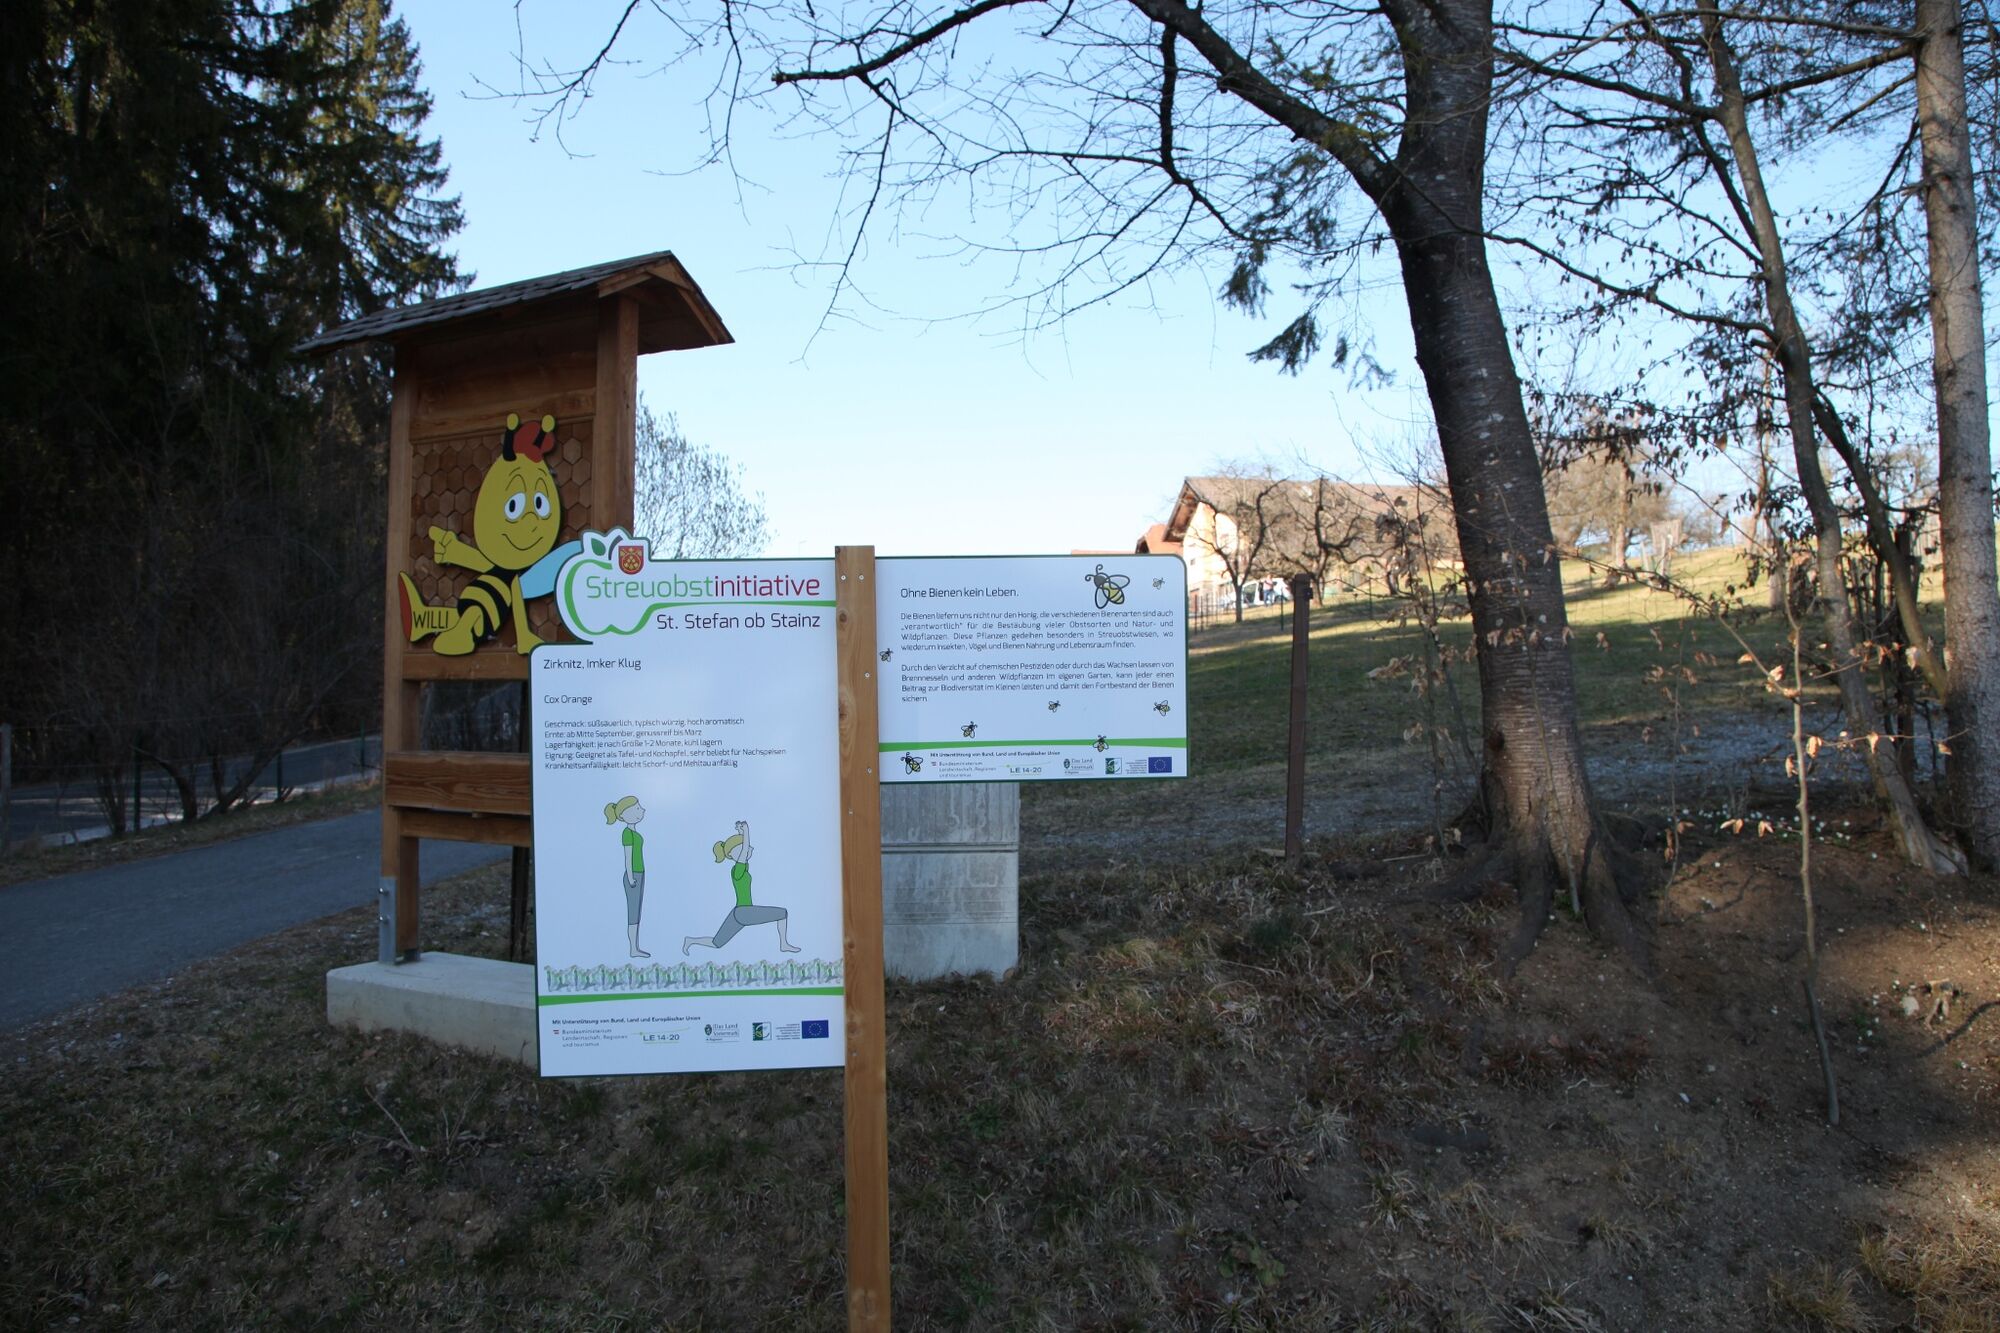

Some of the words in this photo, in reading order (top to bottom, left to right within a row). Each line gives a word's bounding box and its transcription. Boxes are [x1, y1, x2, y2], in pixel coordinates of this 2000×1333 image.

[586, 574, 820, 600] Streuobstinitiative
[900, 587, 927, 598] Ohne
[929, 587, 962, 598] Bienen
[963, 587, 984, 597] kein
[985, 586, 1019, 597] Leben.
[413, 608, 449, 629] WILLI
[900, 612, 912, 620] Die
[912, 612, 935, 620] Bienen
[1004, 611, 1017, 619] den
[1018, 611, 1039, 620] Honig,
[1101, 610, 1142, 618] Bienenarten
[656, 614, 679, 631] St.
[684, 613, 739, 630] Stefan
[744, 613, 766, 629] ob
[770, 612, 820, 629] Stainz
[1132, 620, 1156, 628] Natur-
[953, 632, 973, 640] Diese
[976, 632, 1008, 640] Pflanzen
[1011, 632, 1043, 641] gedeihen
[1046, 631, 1084, 639] besonders
[1098, 631, 1159, 639] Streuobstwiesen,
[901, 643, 936, 651] wiederum
[937, 643, 968, 651] Insekten,
[969, 642, 987, 652] Vögel
[1026, 642, 1055, 651] Nahrung
[1056, 641, 1069, 649] und
[1070, 641, 1112, 649] Lebensraum
[543, 658, 585, 671] Zirknitz,
[586, 657, 616, 668] Imker
[618, 657, 641, 671] Klug
[901, 664, 922, 672] Durch
[937, 663, 965, 671] Verzicht
[1093, 661, 1105, 669] das
[967, 673, 996, 681] anderen
[999, 673, 1044, 681] Wildpflanzen
[1058, 672, 1085, 681] eigenen
[1087, 672, 1113, 680] Garten,
[1116, 671, 1133, 679] kann
[1135, 671, 1153, 680] jeder
[901, 684, 927, 694] Beitrag
[995, 683, 1020, 691] Kleinen
[1060, 682, 1080, 690] damit
[1151, 681, 1175, 689] Bienen
[543, 694, 560, 704] Cox
[561, 693, 593, 706] Orange
[544, 720, 585, 728] Geschmack:
[635, 719, 661, 728] typisch
[661, 718, 686, 728] würzig,
[566, 730, 576, 738] ab
[576, 730, 594, 738] Mitte
[595, 730, 635, 739] September,
[642, 1034, 655, 1042] LE
